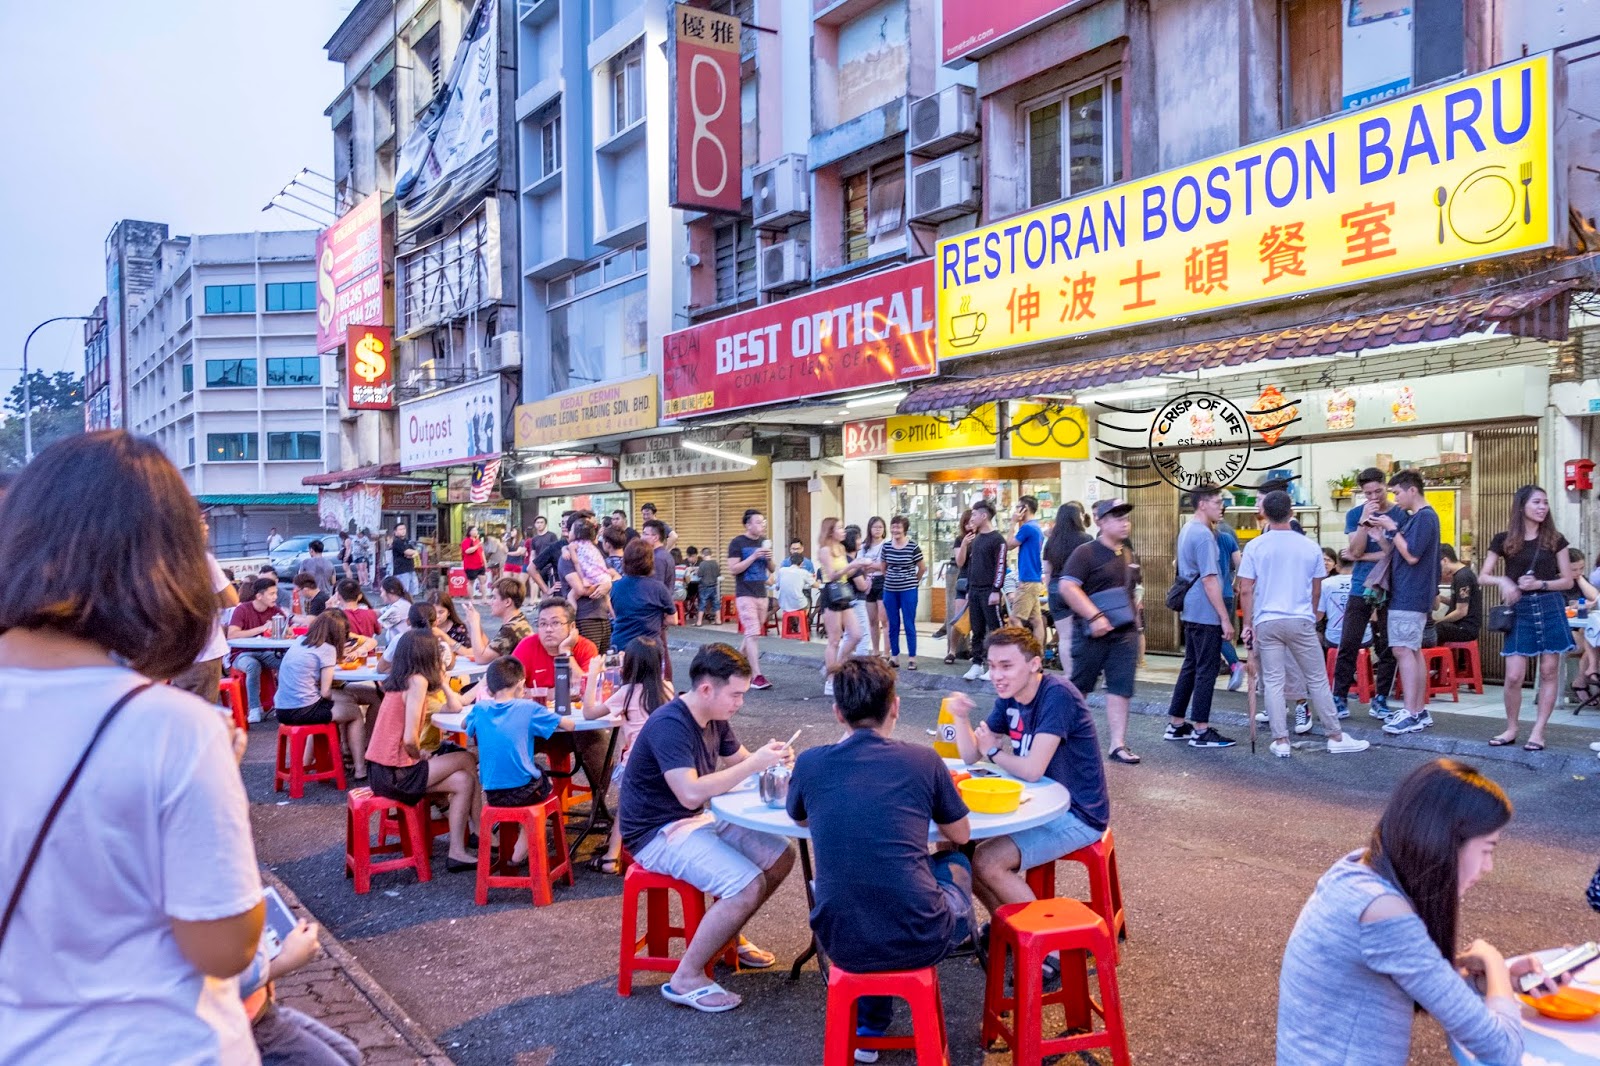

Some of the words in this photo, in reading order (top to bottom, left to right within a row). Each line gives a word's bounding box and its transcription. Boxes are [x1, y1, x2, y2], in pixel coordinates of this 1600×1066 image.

[681, 12, 734, 44] 優雅
[943, 196, 1126, 289] RESTORAN
[1143, 132, 1336, 242] BOSTON
[1359, 68, 1532, 185] BARU
[716, 323, 782, 375] BEST
[791, 286, 934, 358] OPTICAL
[735, 364, 794, 388] CONTACT
[535, 412, 557, 429] KWONG
[560, 410, 579, 425] LEONG
[581, 403, 610, 421] TRADING
[633, 395, 650, 412] BHD.
[560, 393, 583, 410] KEDAI
[589, 387, 620, 405] CERMIN
[409, 414, 452, 447] Outpost
[645, 436, 673, 451] KEDAI
